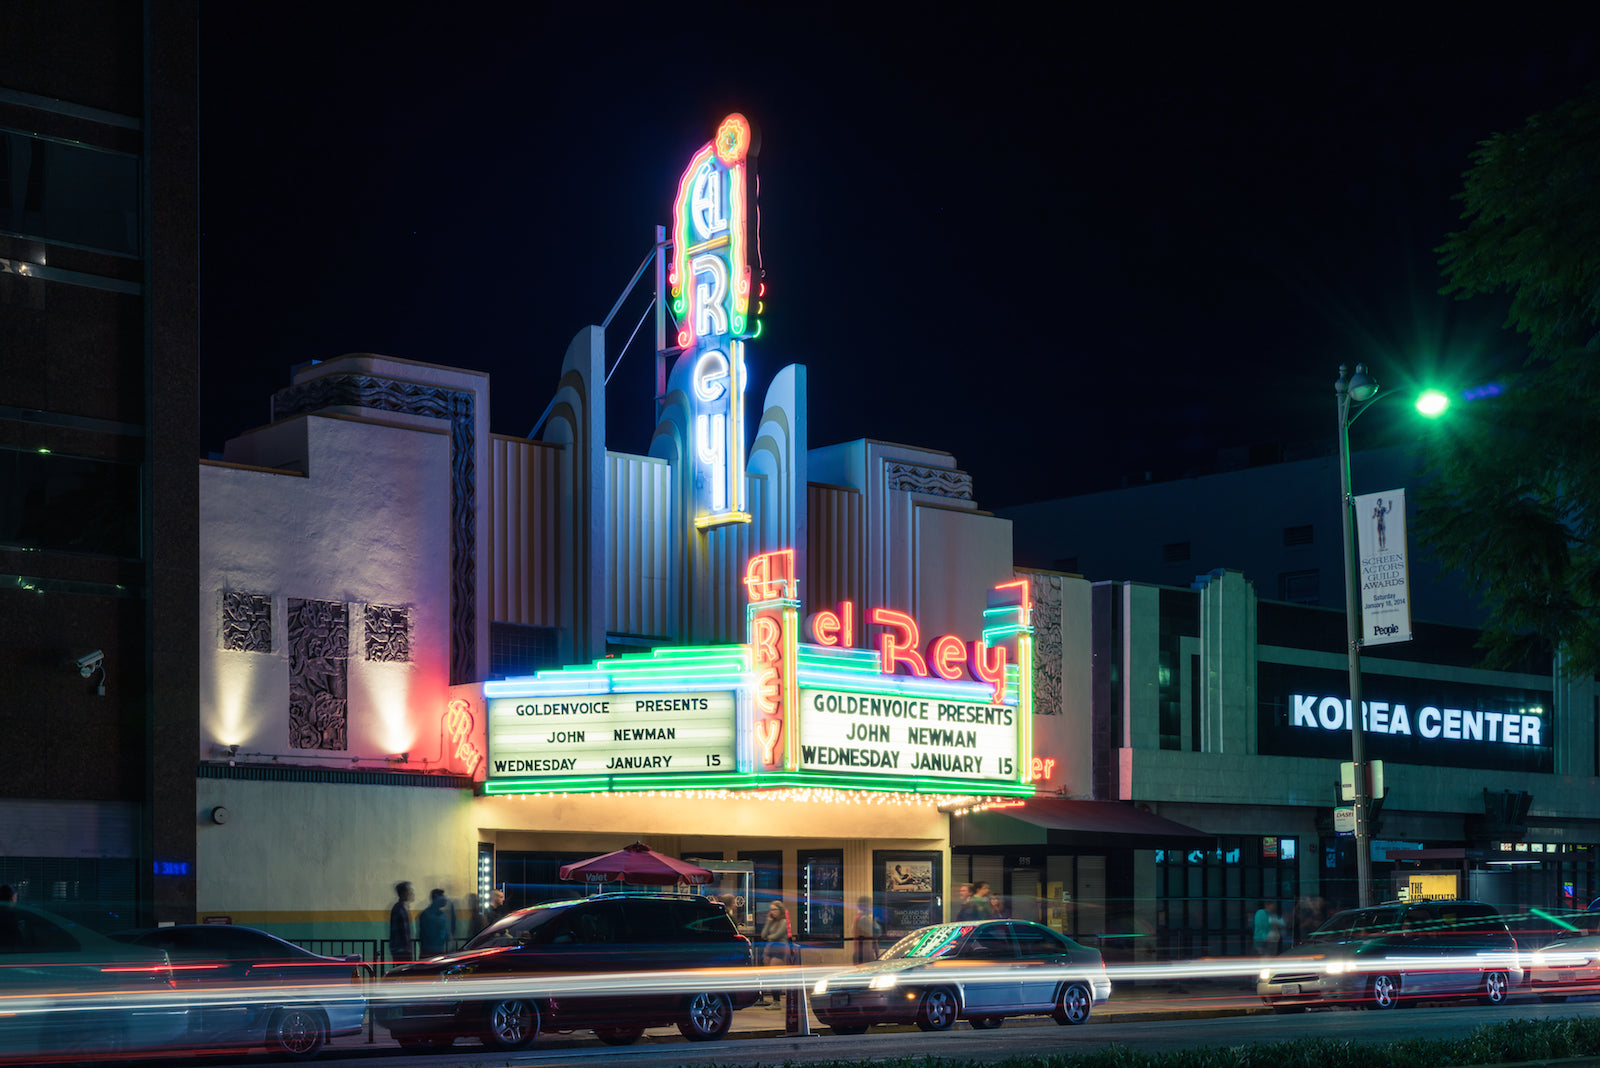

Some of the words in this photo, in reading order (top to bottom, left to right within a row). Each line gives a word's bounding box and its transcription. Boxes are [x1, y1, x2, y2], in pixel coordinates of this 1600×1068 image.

[1361, 554, 1403, 567] SCREEN
[1362, 562, 1405, 575] ACTORS
[1363, 577, 1405, 590] AWARDS
[1367, 571, 1400, 582] GUILD
[1373, 624, 1399, 636] People
[812, 600, 853, 647] el
[870, 607, 1004, 705] Rey
[753, 616, 782, 766] REY
[515, 702, 610, 716] GOLDENVOICE
[635, 698, 709, 712] PRESENTS
[813, 694, 929, 720] GOLDENVOICE
[937, 704, 1013, 726] PRESENTS
[1289, 694, 1412, 735] KOREA
[1418, 706, 1542, 745] CENTER
[546, 731, 586, 743] JOHN
[613, 728, 676, 741] NEWMAN
[846, 723, 891, 743] JOHN
[908, 727, 977, 748] NEWMAN
[494, 758, 577, 773] WEDNESDAY
[605, 755, 673, 770] JANUARY
[706, 755, 721, 768] 15
[801, 745, 900, 769] WEDNESDAY
[911, 752, 982, 774] JANUARY
[998, 757, 1013, 775] 15
[585, 873, 607, 882] Valet
[1411, 882, 1422, 894] THE
